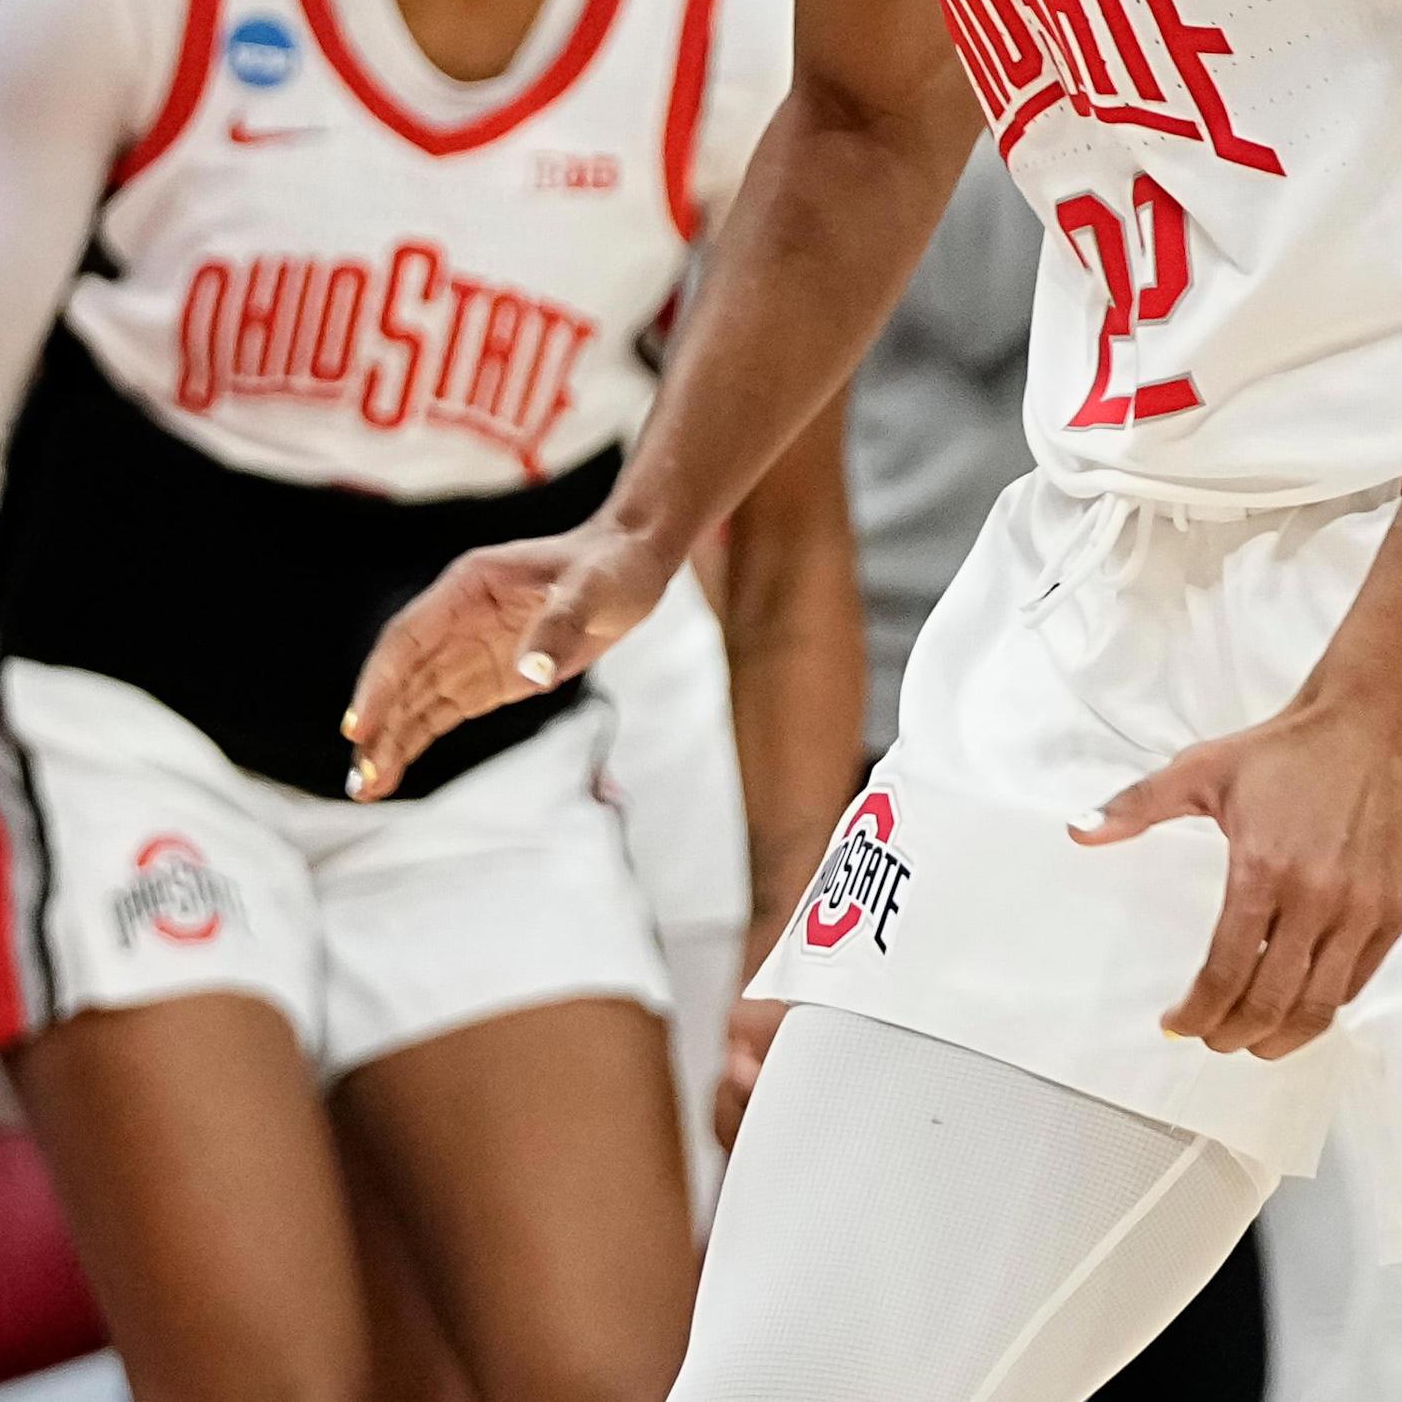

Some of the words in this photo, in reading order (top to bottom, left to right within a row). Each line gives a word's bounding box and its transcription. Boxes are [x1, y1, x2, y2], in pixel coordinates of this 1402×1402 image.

[176, 254, 368, 414] OHIO
[361, 243, 594, 484] STATE
[1056, 173, 1204, 431] 22
[829, 829, 911, 955] STATE
